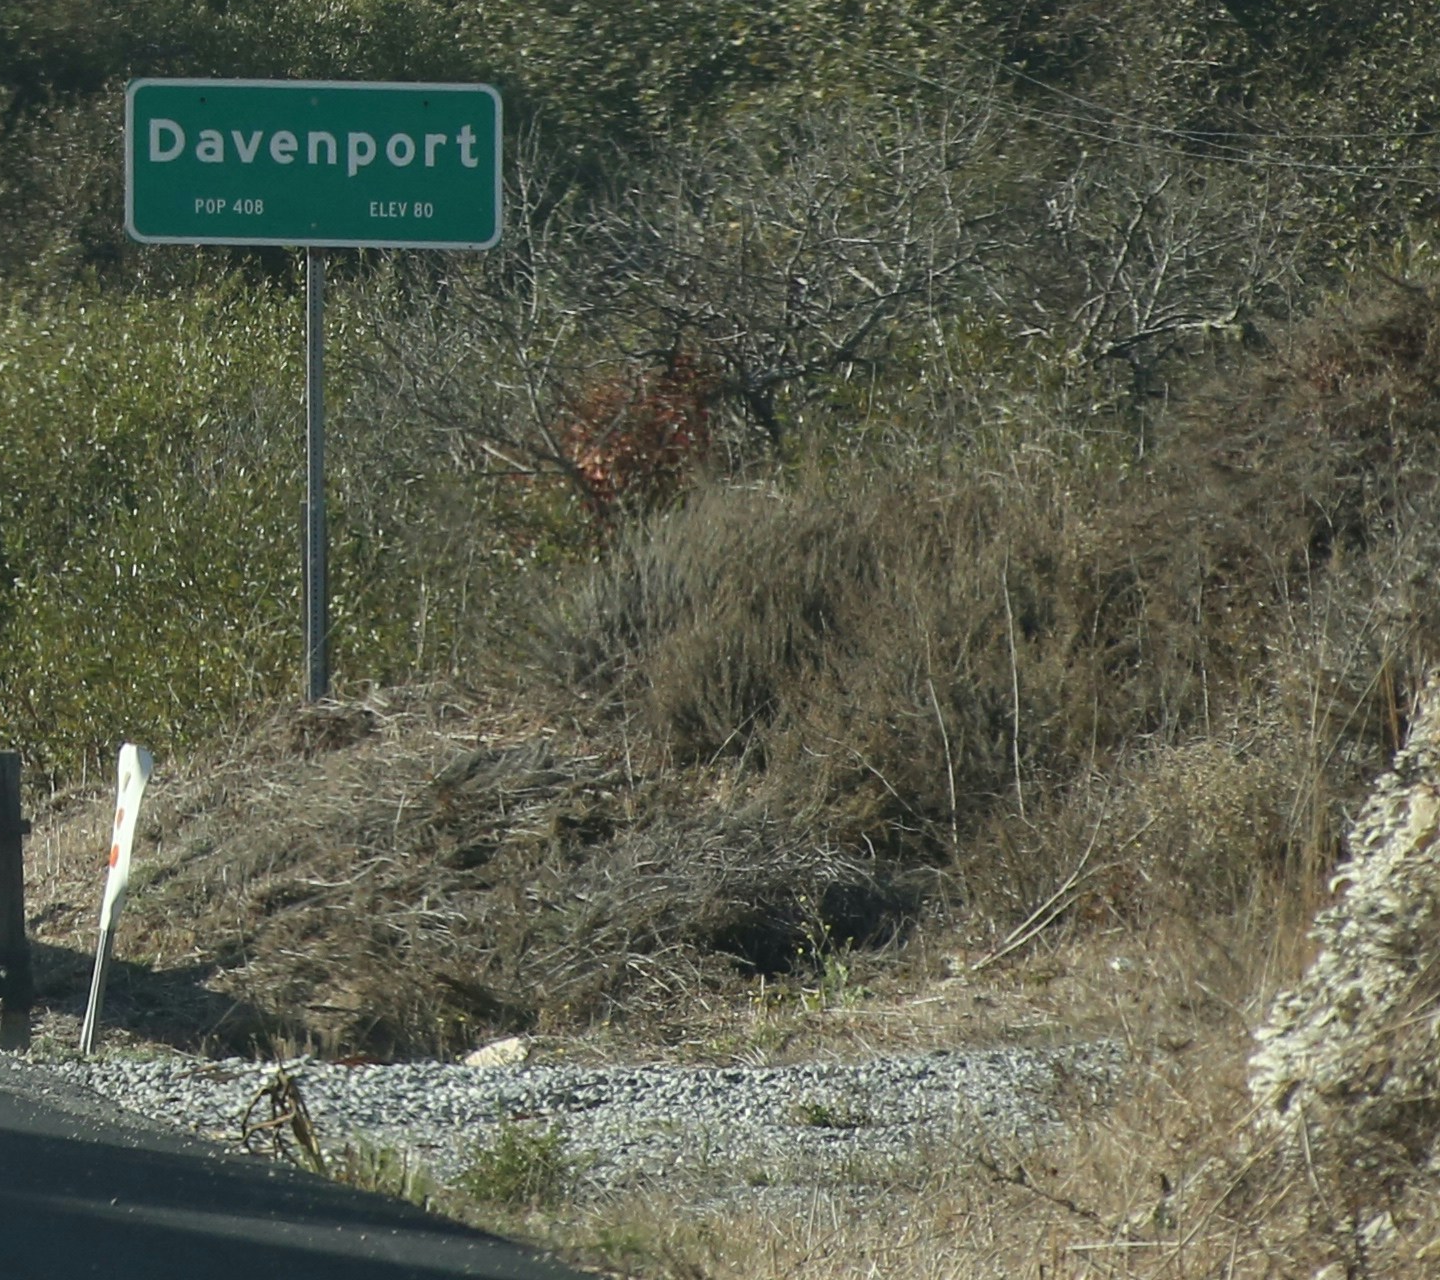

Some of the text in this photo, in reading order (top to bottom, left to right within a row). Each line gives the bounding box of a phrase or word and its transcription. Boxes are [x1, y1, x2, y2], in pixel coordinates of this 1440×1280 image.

[148, 117, 479, 178] Davenport
[194, 198, 434, 219] POP 408 ELEV 80
